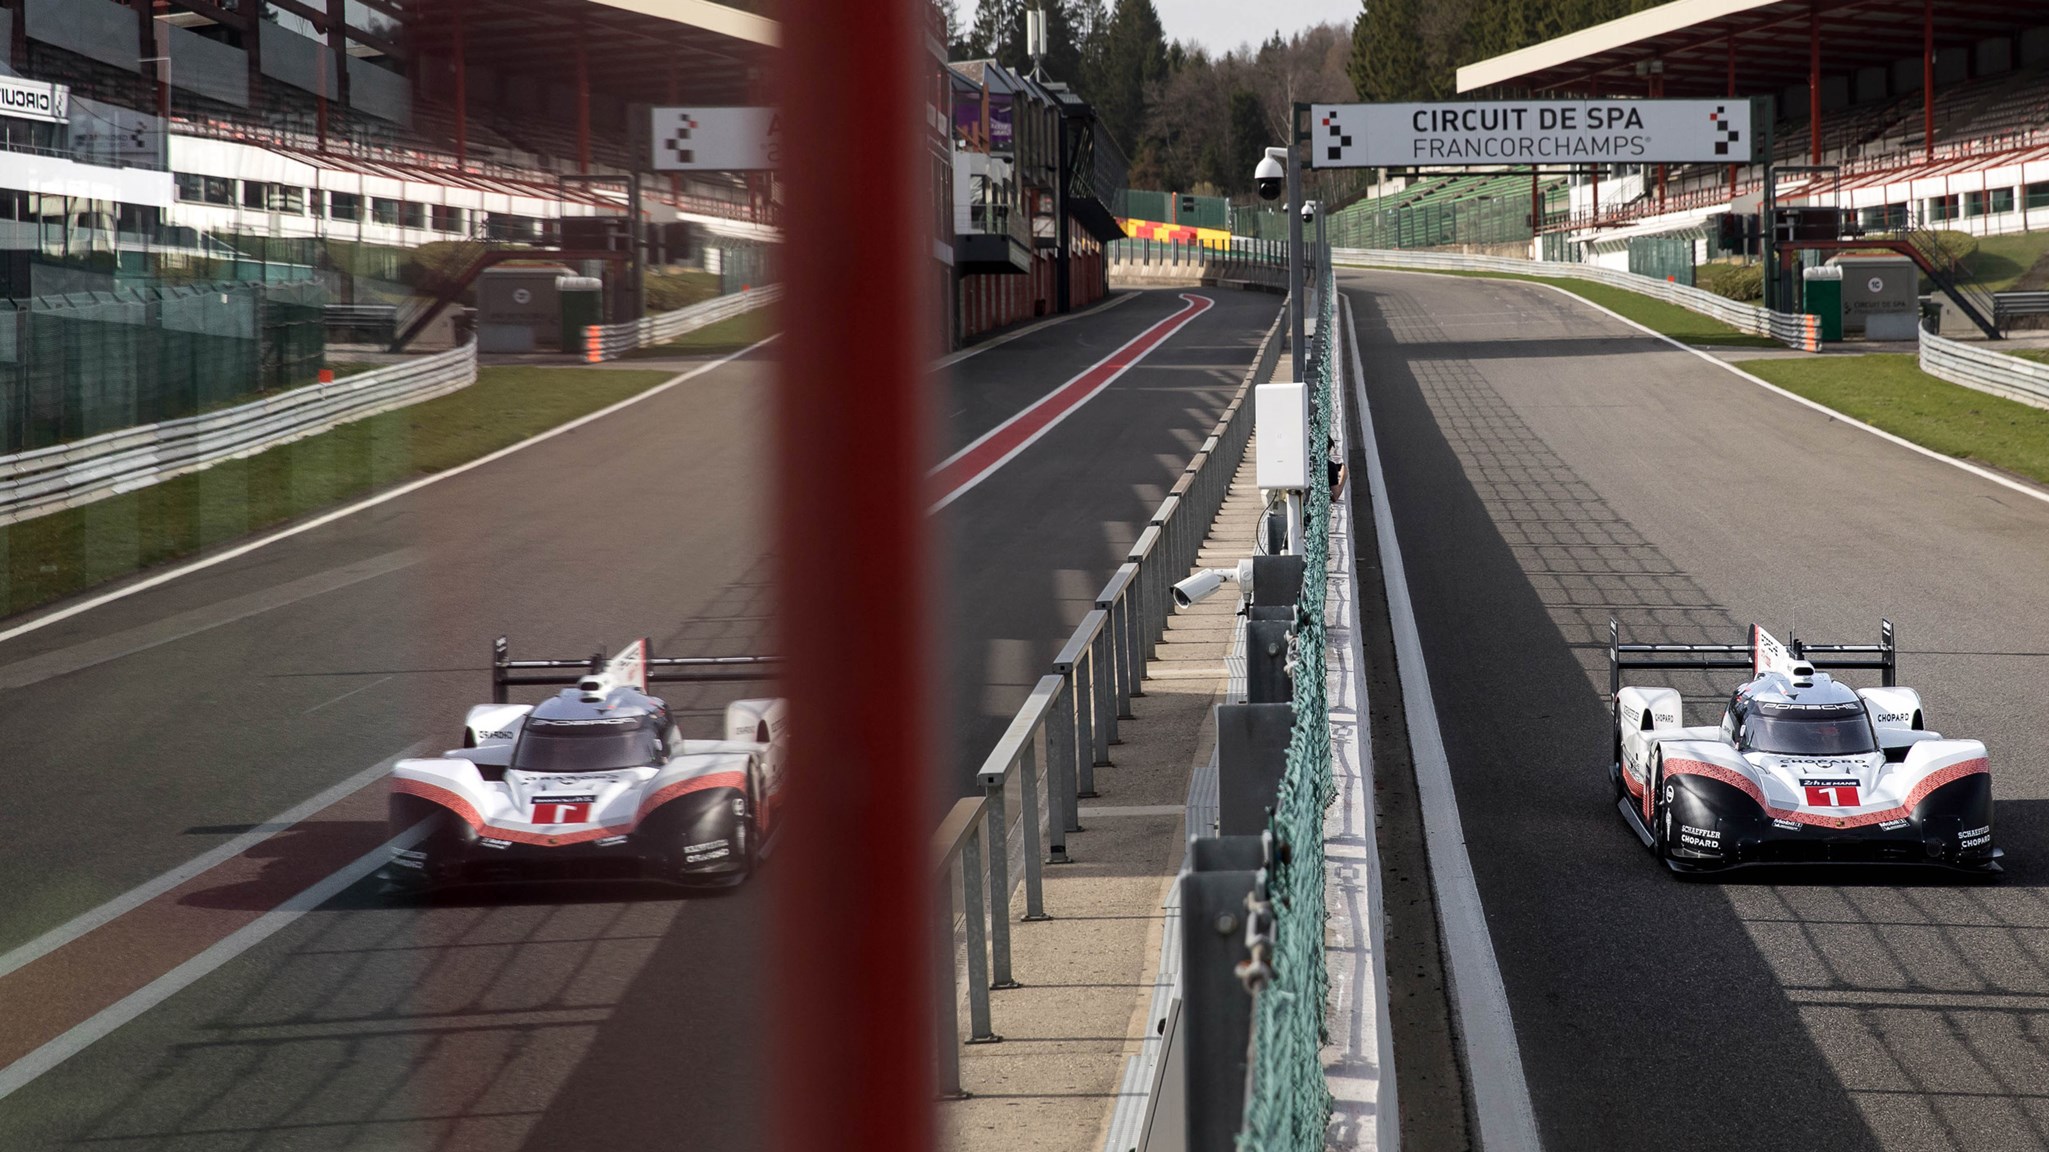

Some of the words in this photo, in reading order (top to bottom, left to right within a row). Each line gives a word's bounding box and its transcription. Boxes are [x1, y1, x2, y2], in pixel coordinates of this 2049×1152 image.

[1412, 108, 1528, 132] CIRCUIT
[1539, 108, 1577, 131] DE
[1587, 107, 1644, 130] SPA
[1413, 136, 1646, 159] FRANCORCHAMPS
[1762, 702, 1859, 711] PORSCHE
[1655, 713, 1674, 723] CHOPARD
[1878, 713, 1910, 723] CHOPARD
[1818, 787, 1840, 806] 1
[1681, 824, 1721, 839] SCHAEFFLER
[1681, 834, 1719, 848] CHOPARD
